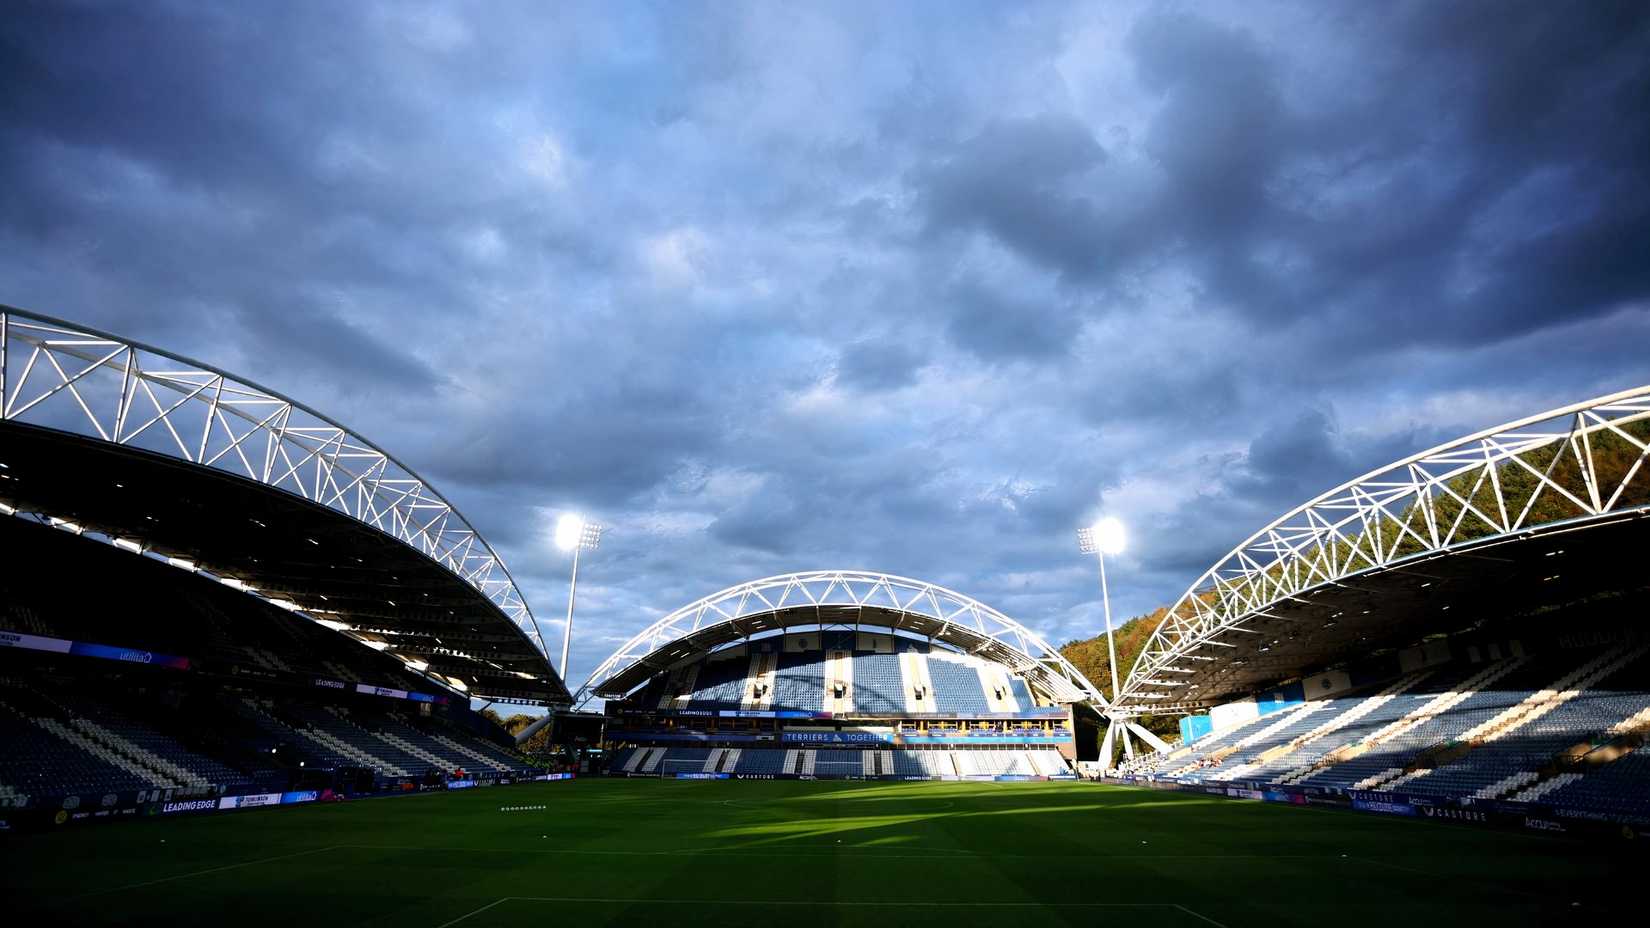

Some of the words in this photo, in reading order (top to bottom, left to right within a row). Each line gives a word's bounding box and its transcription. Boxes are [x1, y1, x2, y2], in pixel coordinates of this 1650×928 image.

[786, 733, 828, 741] TERRIERS
[162, 801, 196, 813] LEADING
[196, 799, 216, 810] EDGE
